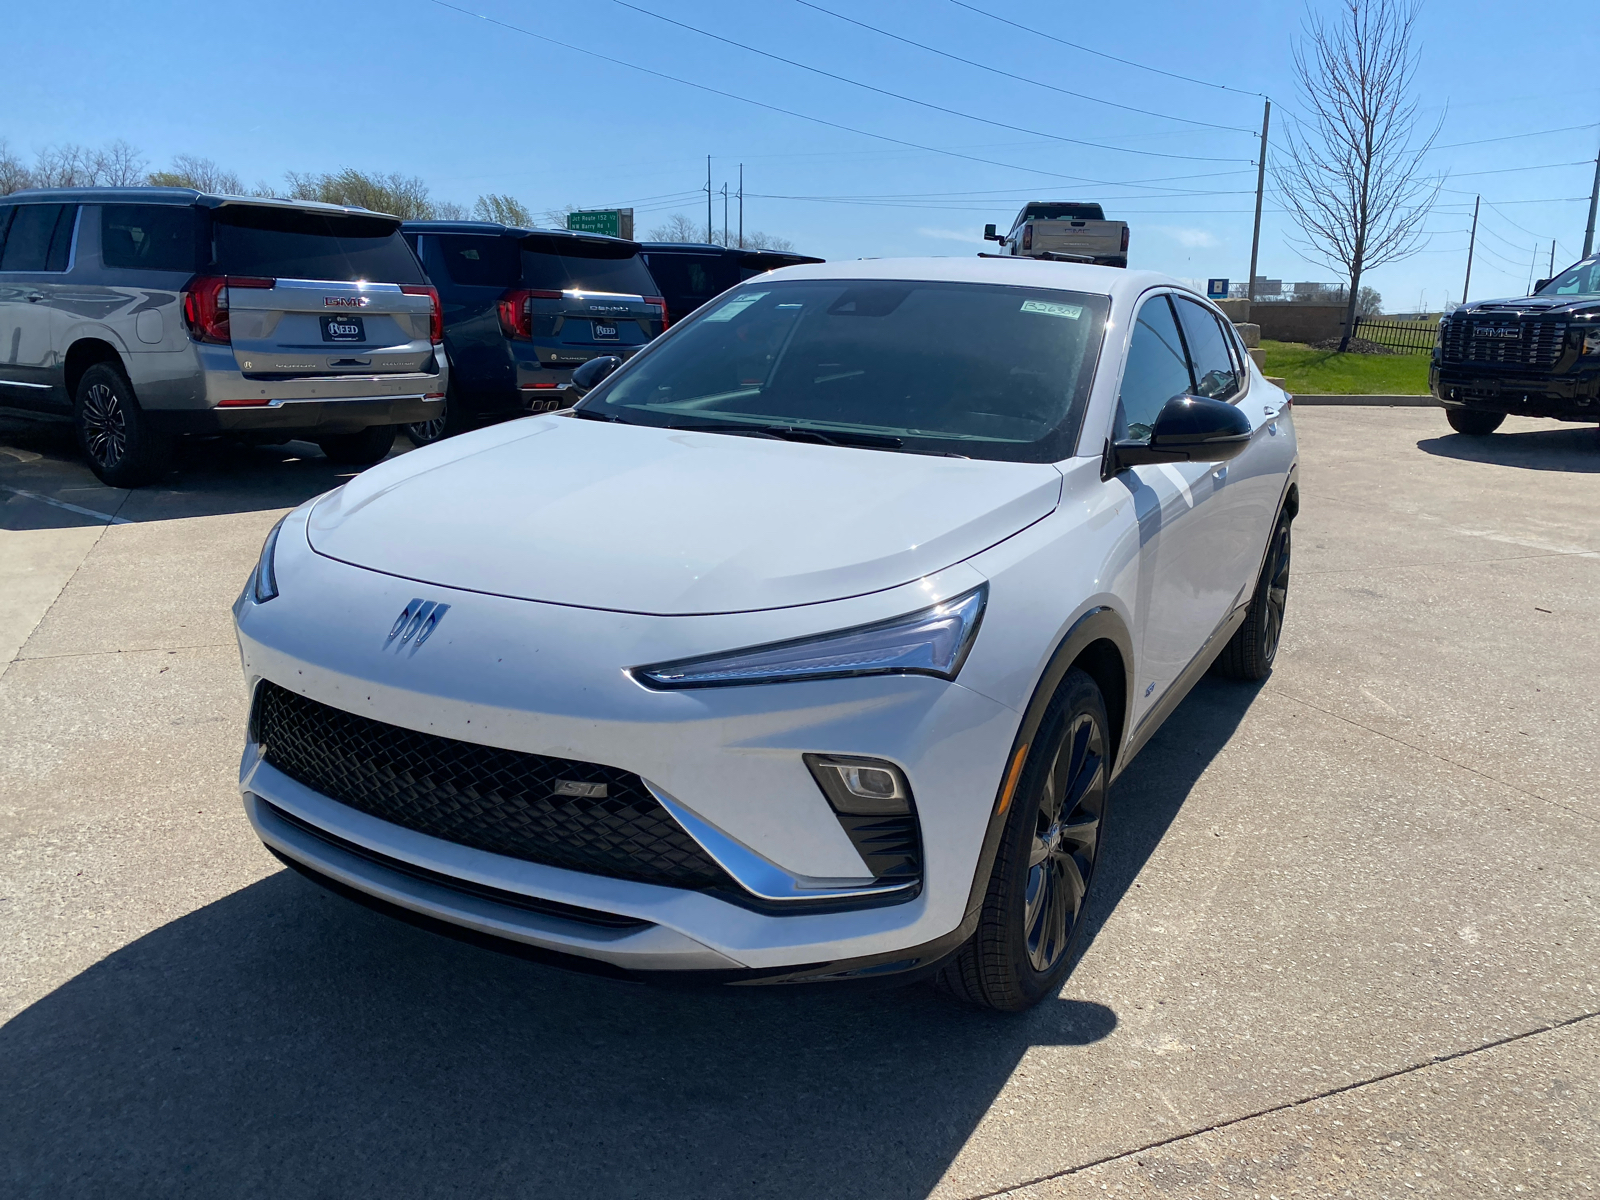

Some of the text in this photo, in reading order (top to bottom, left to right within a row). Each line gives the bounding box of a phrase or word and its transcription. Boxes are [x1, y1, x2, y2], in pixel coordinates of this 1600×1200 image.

[323, 296, 370, 308] GMC
[1474, 326, 1520, 338] GMC
[558, 782, 604, 796] ST
